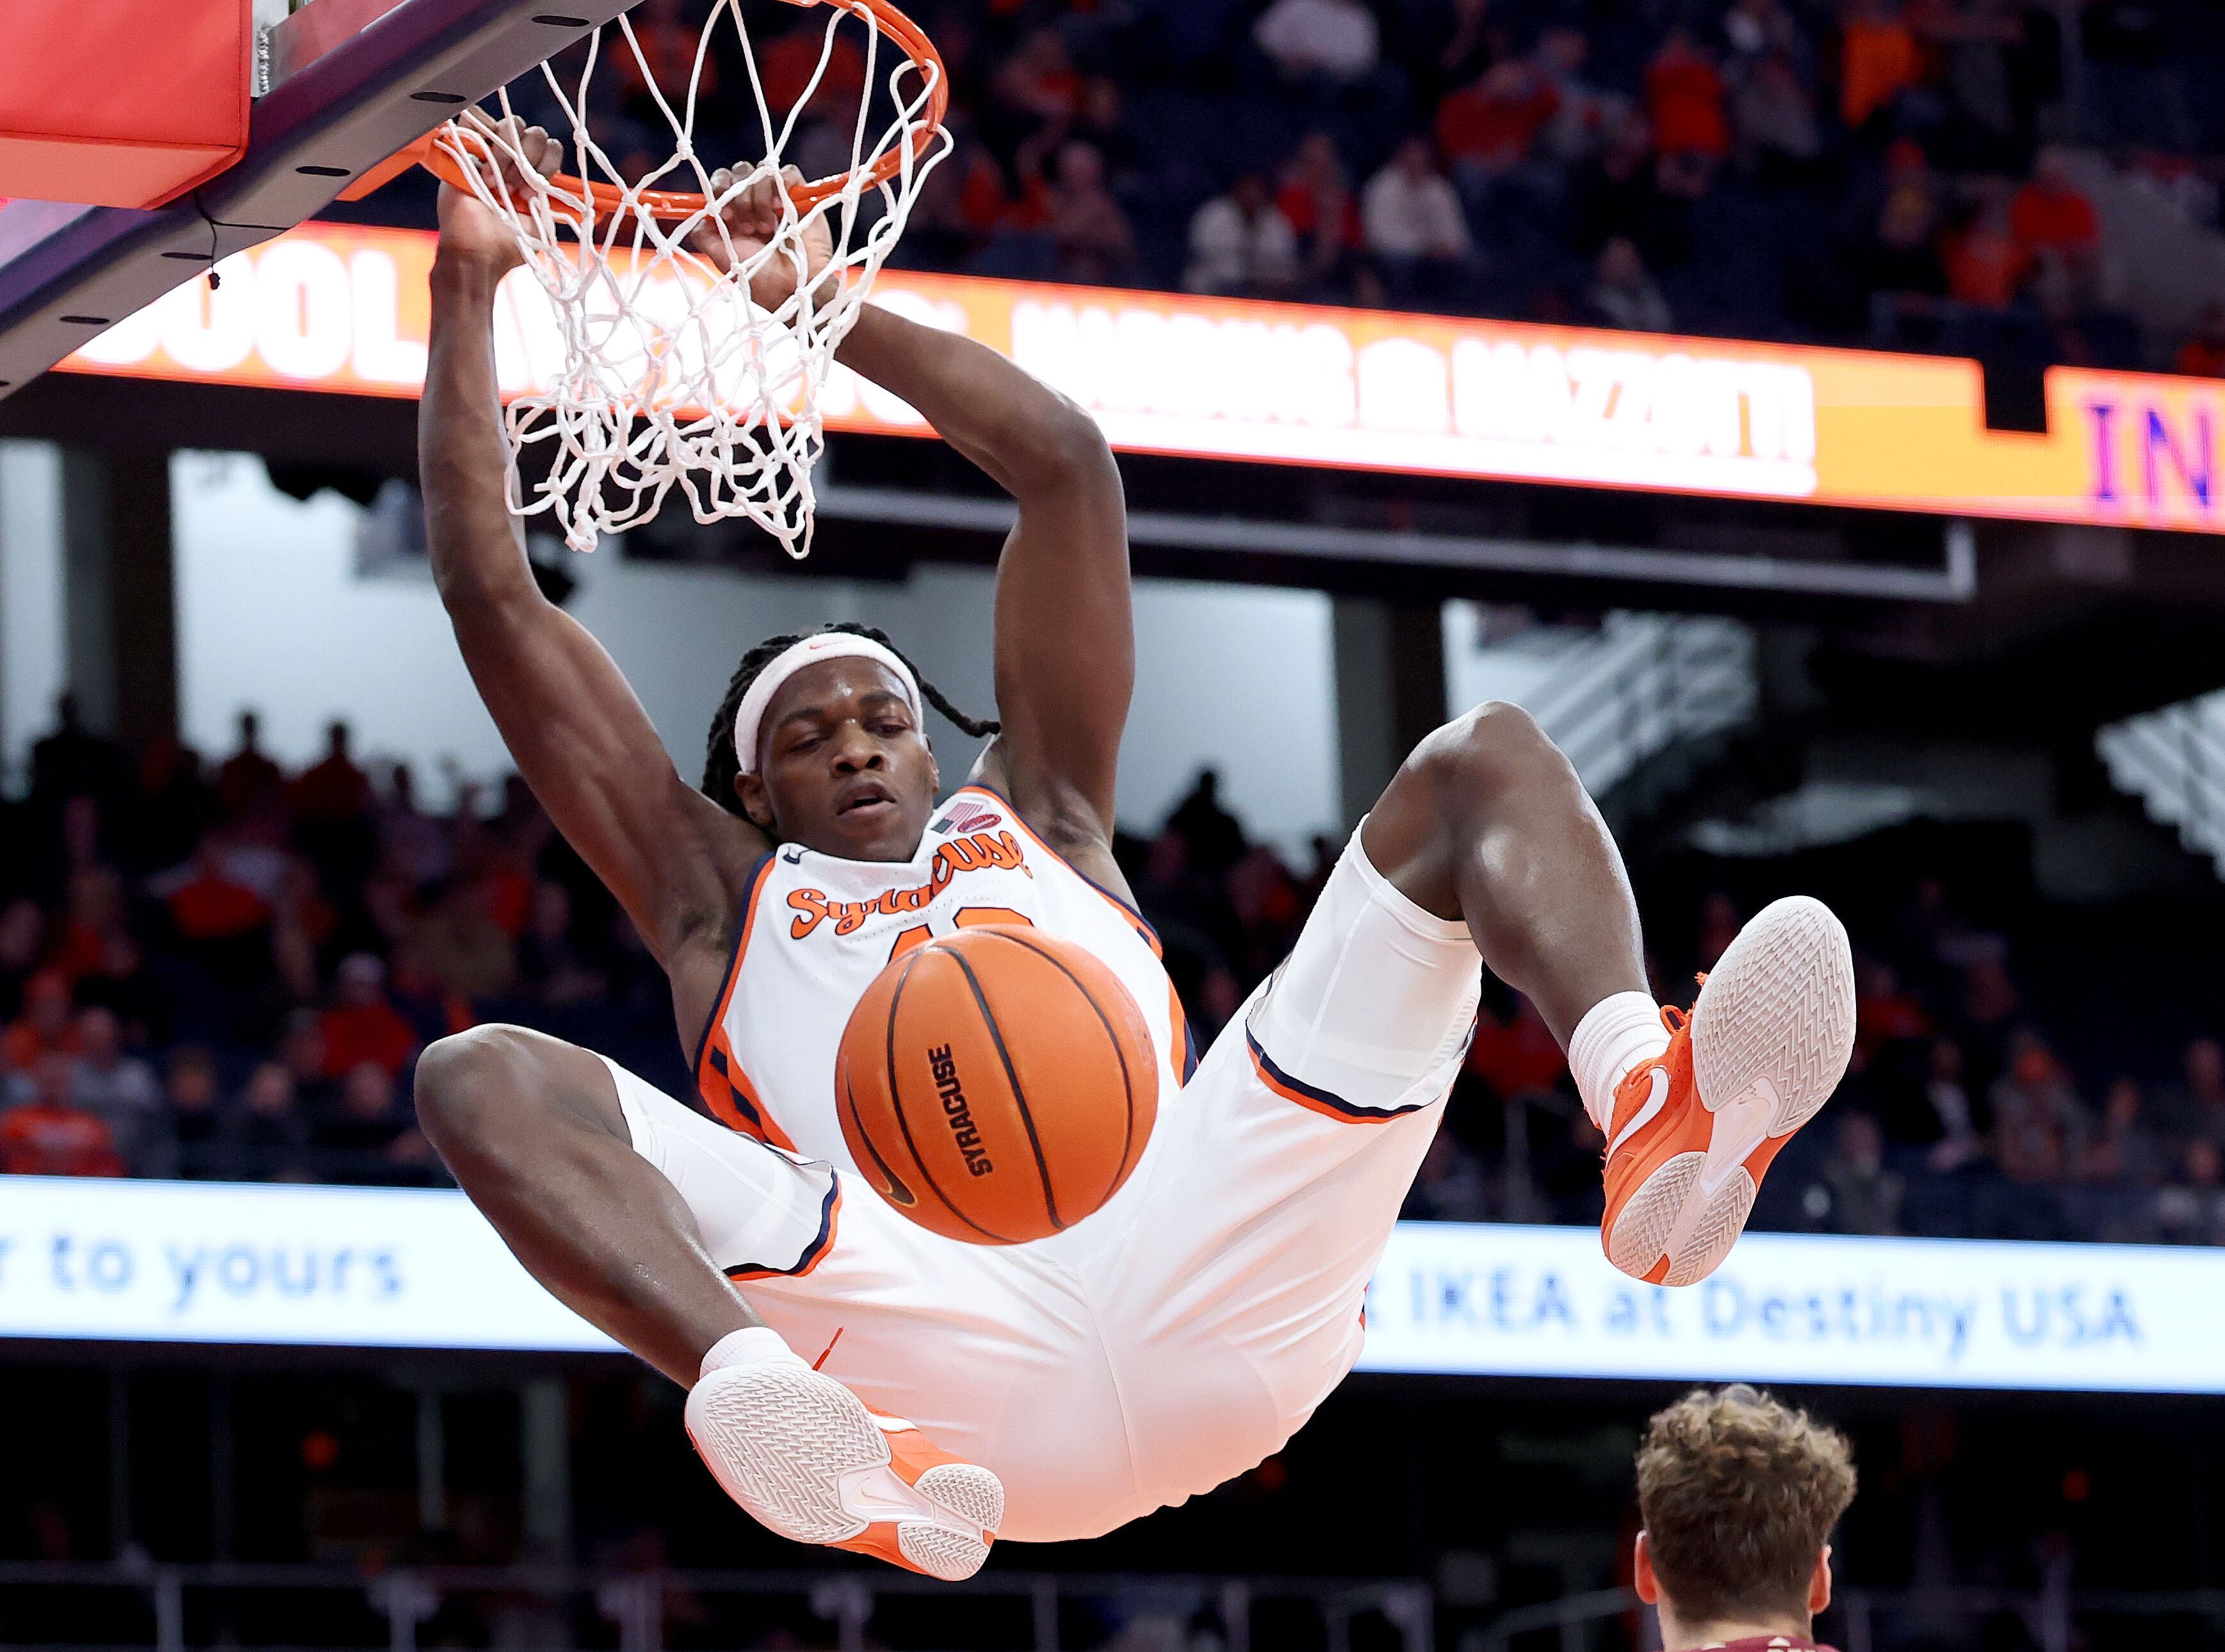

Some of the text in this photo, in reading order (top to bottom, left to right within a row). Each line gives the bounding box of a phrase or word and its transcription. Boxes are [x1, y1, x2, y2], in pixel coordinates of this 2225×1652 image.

[76, 240, 428, 384] OOL
[786, 830, 1034, 940] Syracuse
[927, 1042, 993, 1178] SYRACUSE
[49, 1235, 134, 1294] to
[163, 1238, 405, 1317] yours
[1410, 1266, 1577, 1333] IKEA
[1606, 1284, 1674, 1337] at
[1704, 1273, 1975, 1362] Destiny
[2000, 1282, 2148, 1350] USA
